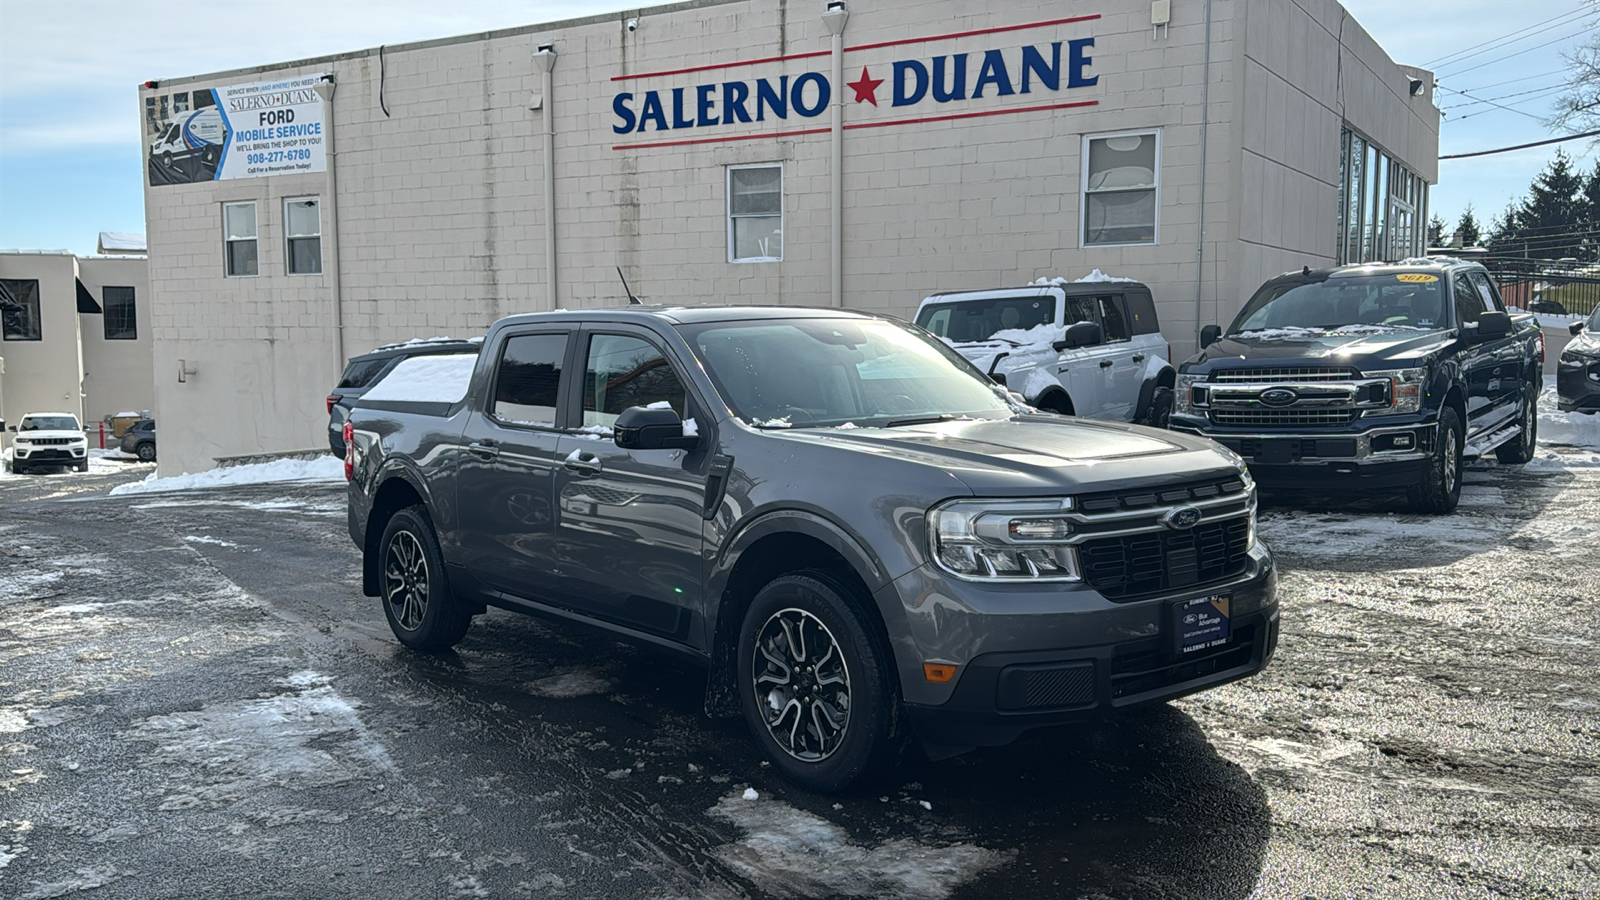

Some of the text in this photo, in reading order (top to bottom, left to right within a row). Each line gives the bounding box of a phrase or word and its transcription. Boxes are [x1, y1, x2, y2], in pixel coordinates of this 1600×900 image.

[227, 88, 245, 96] SERVICE
[260, 84, 271, 92] (AND
[272, 82, 290, 91] WHERE)
[290, 80, 301, 88] YOU
[301, 78, 314, 86] NEED
[612, 37, 1100, 134] SALERNO DUANE
[230, 90, 317, 111] SALERNO DUANE
[259, 109, 295, 126] FORD
[236, 123, 321, 142] MOBILE SERVICE
[236, 144, 252, 152] WE'LL
[253, 142, 270, 151] BRING
[282, 139, 298, 147] SHOP
[299, 138, 306, 146] TO
[308, 137, 322, 145] YOU!
[247, 149, 311, 165] 908-277-6780
[247, 166, 256, 174] Call
[269, 163, 295, 171] Reservation
[296, 162, 311, 170] Today!
[1198, 617, 1221, 626] Advantage
[1183, 638, 1226, 653] SALERNO DUANE
